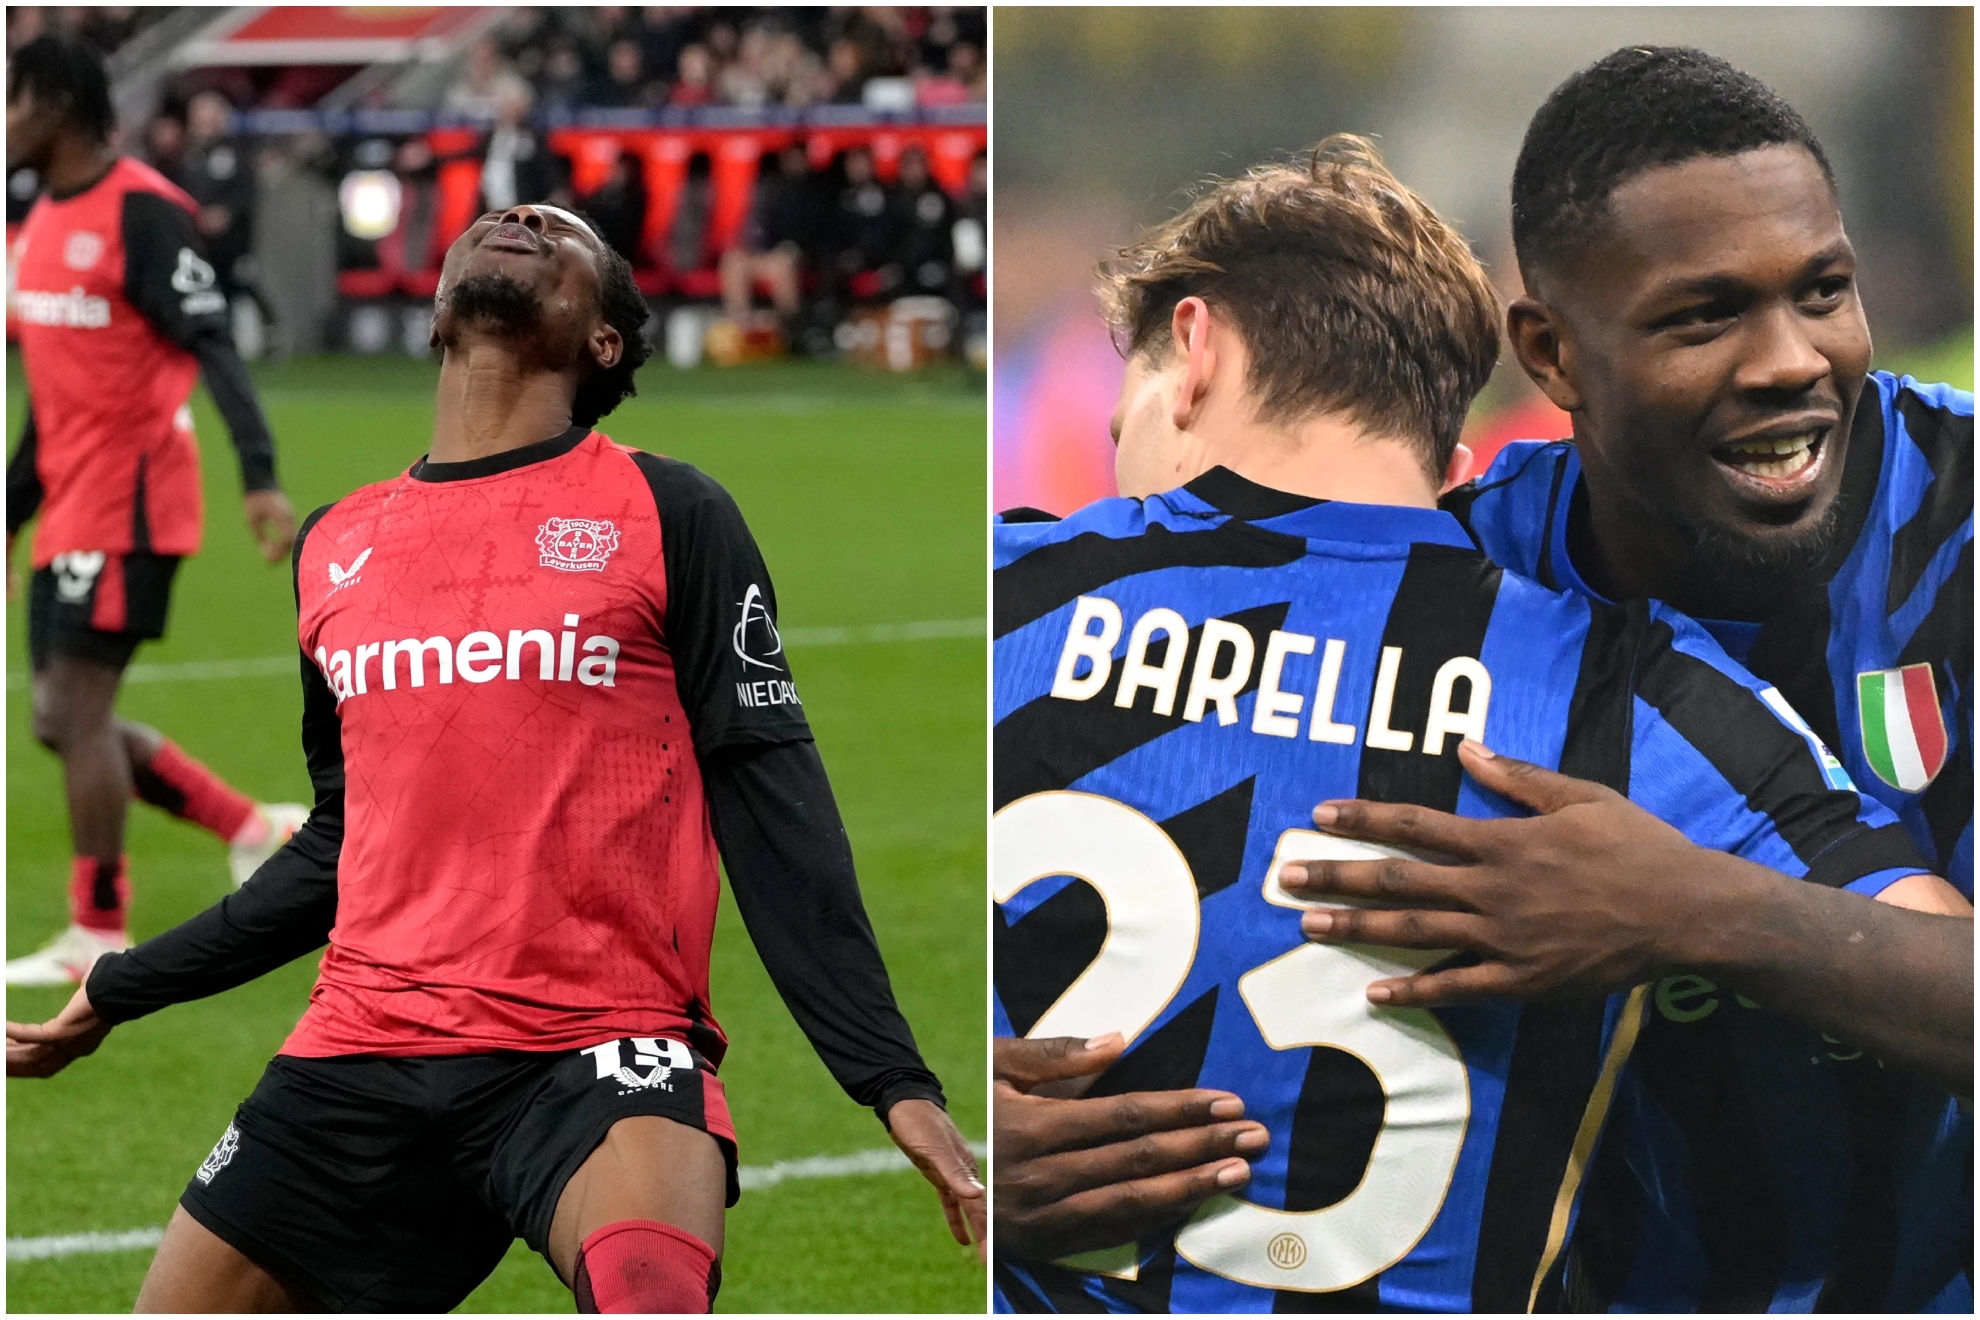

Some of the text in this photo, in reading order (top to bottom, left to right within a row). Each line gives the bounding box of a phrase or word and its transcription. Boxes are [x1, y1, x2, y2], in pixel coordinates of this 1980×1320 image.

[570, 521, 590, 529] 1904
[559, 540, 593, 550] BAYER
[544, 557, 599, 569] Leverkusen
[1050, 594, 1493, 756] BARELLA
[580, 1037, 694, 1080] 19
